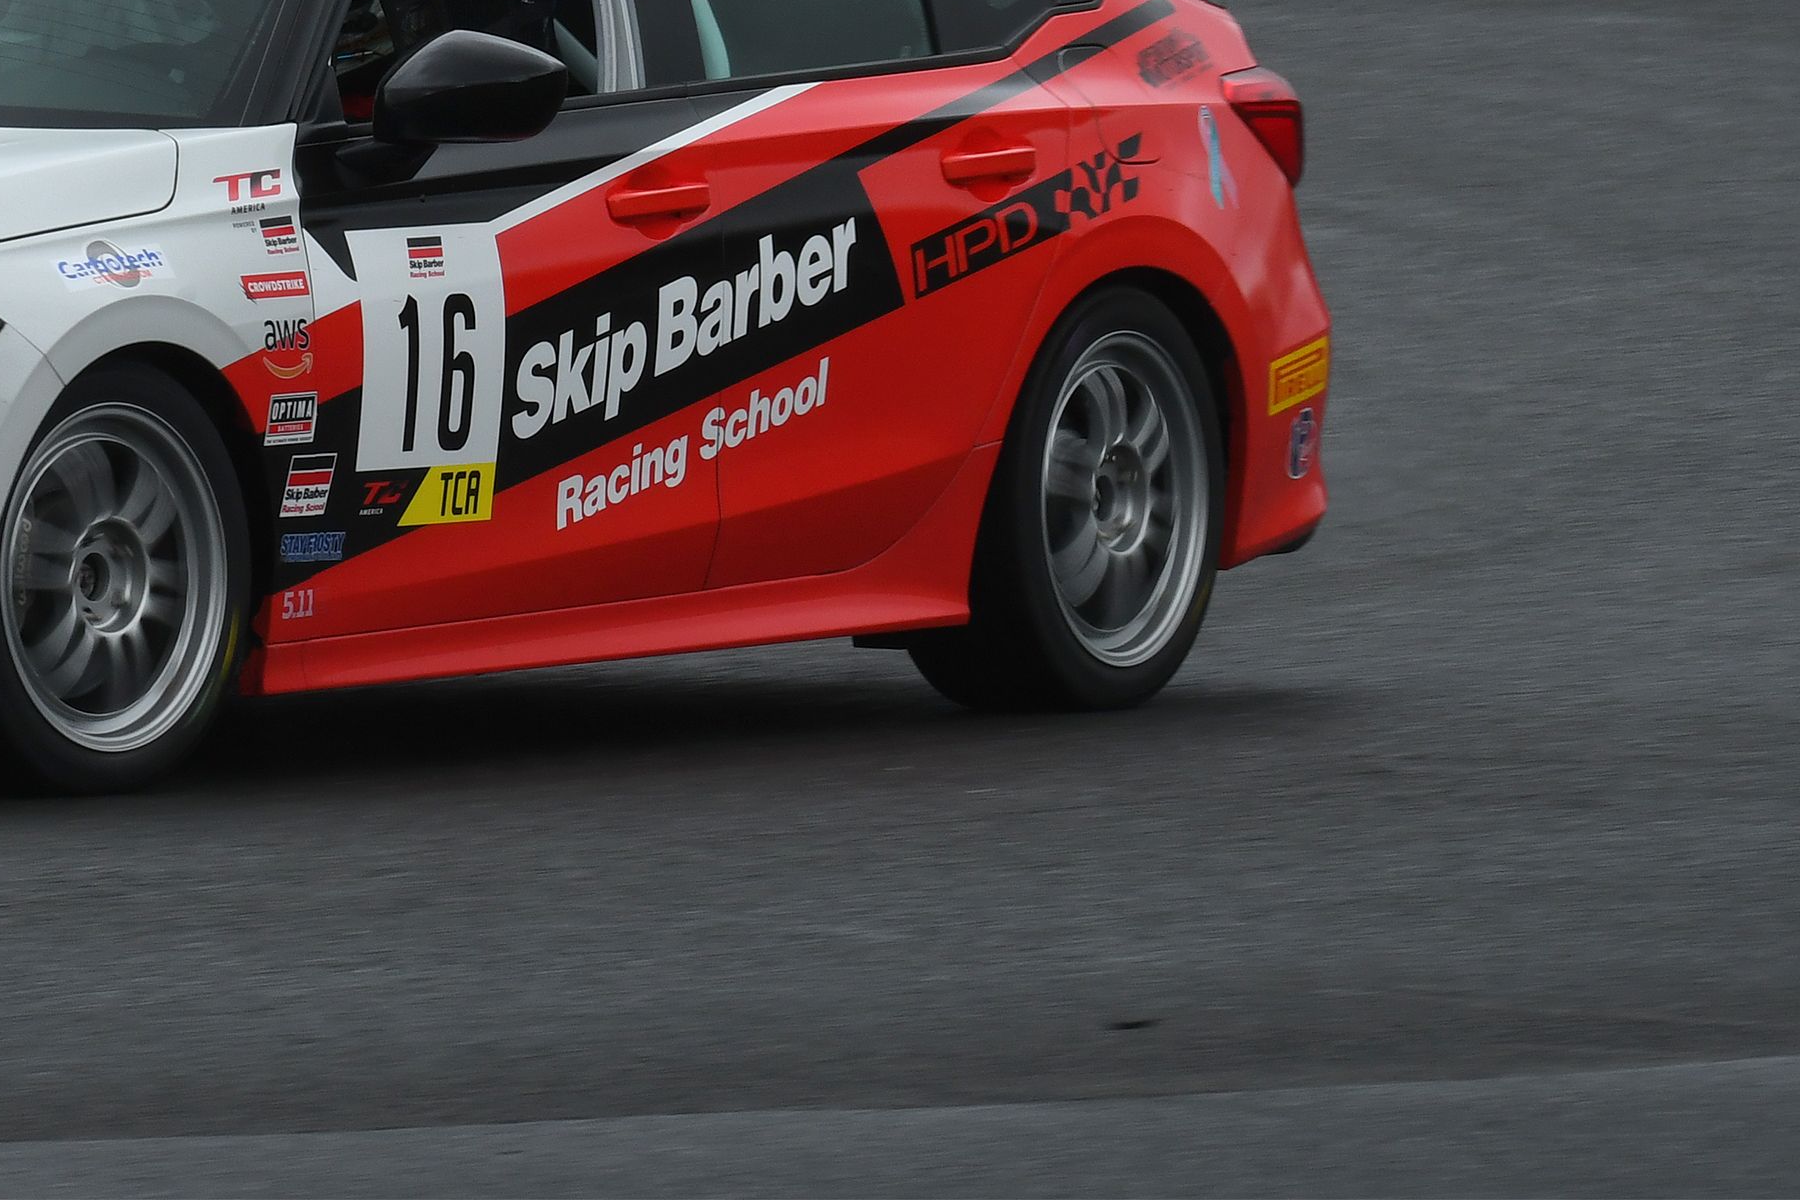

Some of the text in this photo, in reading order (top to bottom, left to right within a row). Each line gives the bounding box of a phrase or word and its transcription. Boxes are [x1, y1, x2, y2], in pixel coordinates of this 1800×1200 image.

[212, 168, 281, 202] TC
[230, 202, 266, 215] AMERICA
[265, 238, 278, 248] Skip
[914, 201, 1039, 293] HPD
[409, 259, 444, 270] Skip Barber
[247, 278, 305, 293] CROWDSTRIKE
[263, 318, 311, 351] aws
[512, 216, 857, 439] Skip Barber
[398, 293, 476, 452] 16
[271, 399, 313, 420] OPTIMA
[556, 356, 830, 532] Racing School
[284, 488, 303, 502] Skip
[440, 470, 481, 517] TCA
[282, 589, 313, 619] 5.11
